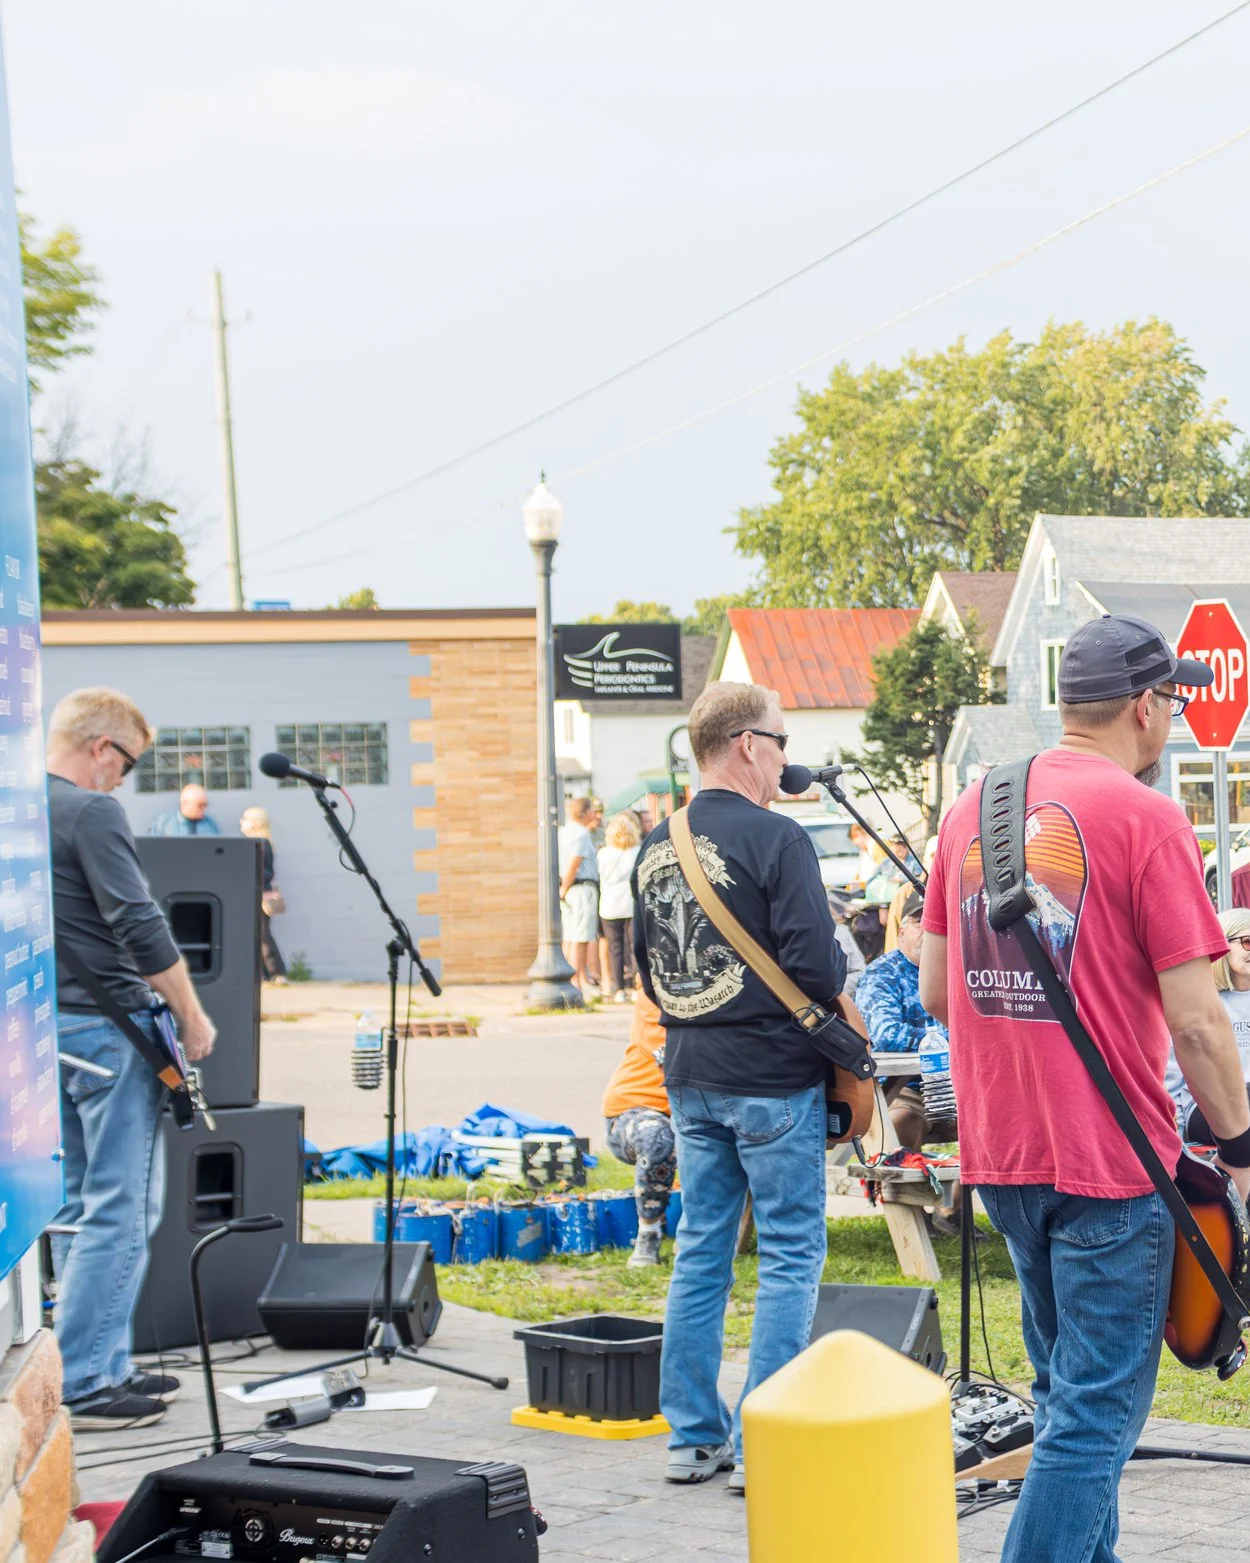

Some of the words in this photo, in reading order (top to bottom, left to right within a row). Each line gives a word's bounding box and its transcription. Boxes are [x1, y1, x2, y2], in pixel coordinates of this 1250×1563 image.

[625, 660, 675, 672] PENINSULA
[966, 969, 1043, 990] COLUM
[1005, 992, 1046, 1002] OUTDOOR
[1014, 1004, 1034, 1012] 1938
[279, 1528, 314, 1546] Bugera
